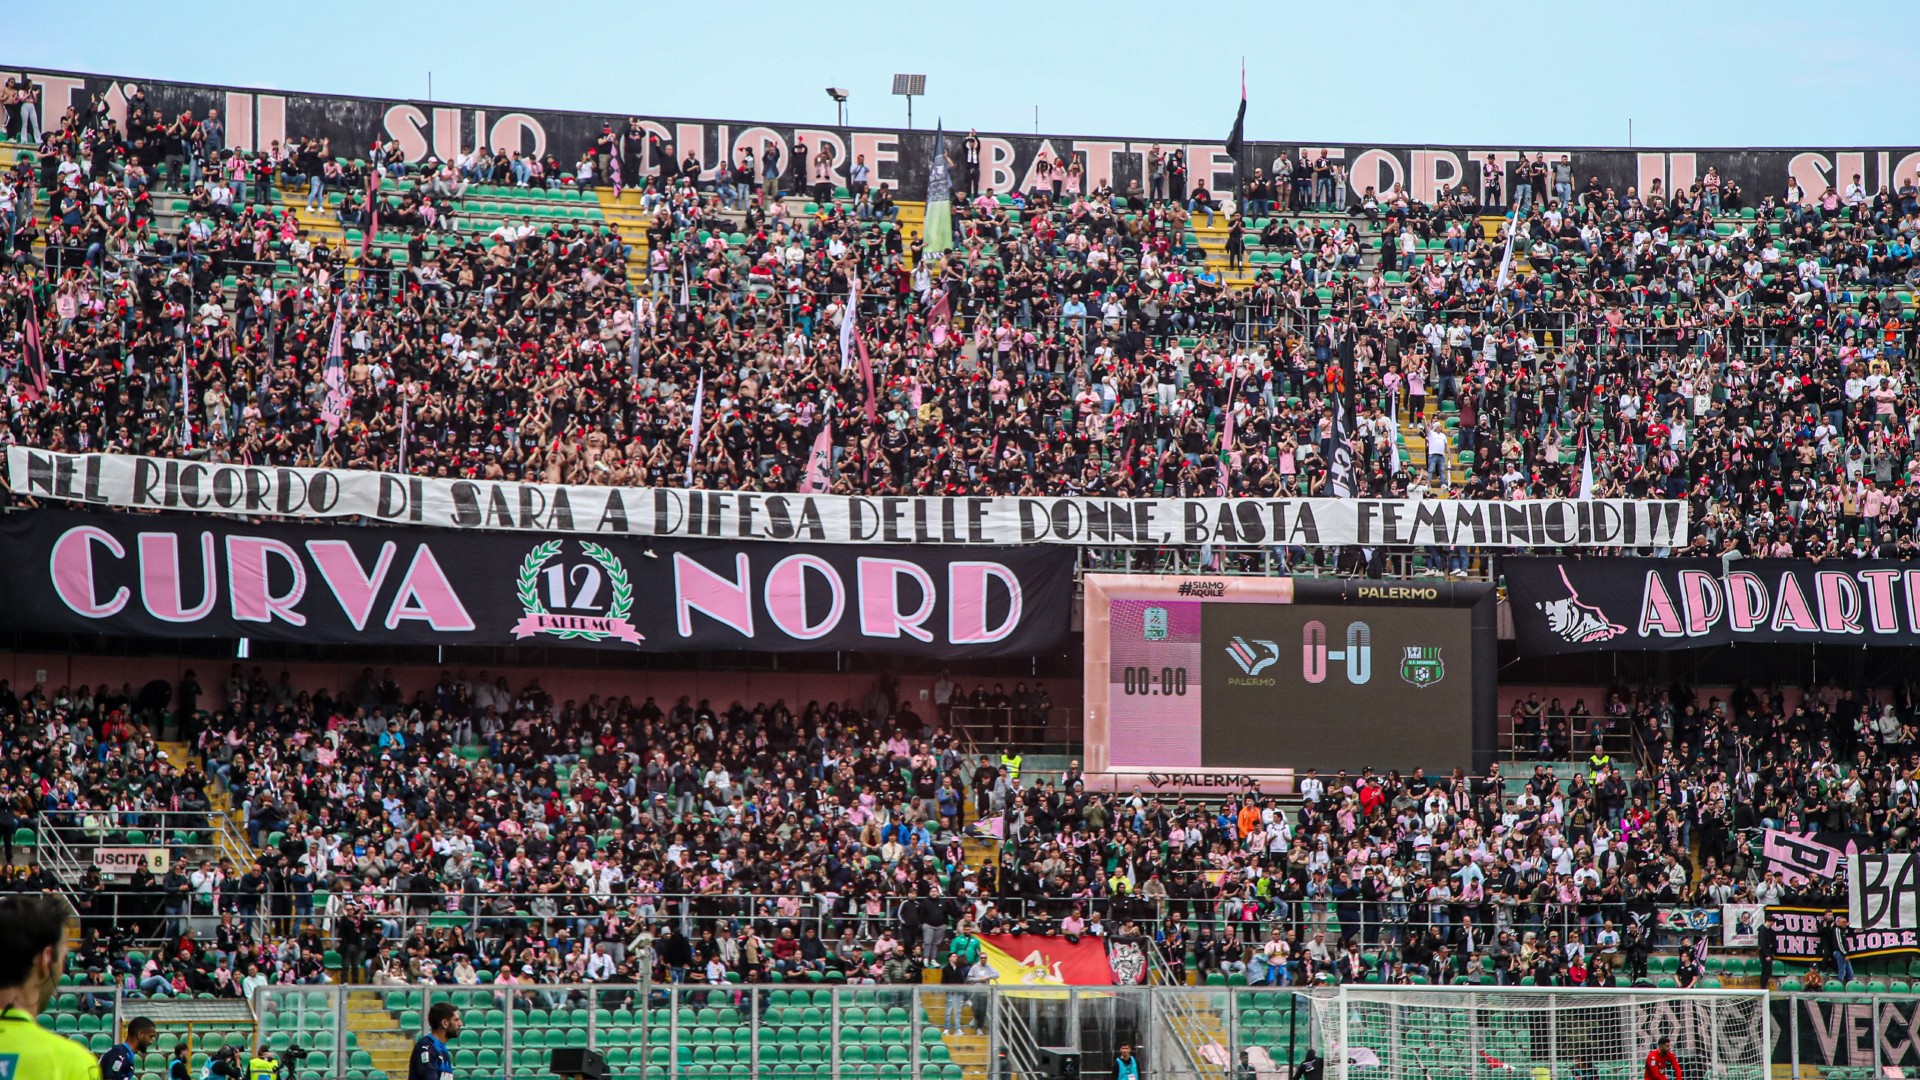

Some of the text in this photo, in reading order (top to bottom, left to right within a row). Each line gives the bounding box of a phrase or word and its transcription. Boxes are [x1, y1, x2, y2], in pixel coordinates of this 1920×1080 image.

[383, 104, 547, 165] SUO
[618, 120, 899, 190] CUORE
[976, 137, 1236, 200] BATTE
[27, 451, 108, 502] NEL
[133, 458, 340, 514] RICORDO
[376, 474, 422, 522] DI
[450, 480, 575, 531] SARA
[596, 488, 629, 532] A
[653, 488, 826, 540] DIFESA
[848, 495, 994, 543] DELLE
[1018, 499, 1171, 543] DONNE,
[1184, 500, 1321, 543] BASTA
[50, 525, 1023, 644] CURVA NORD
[541, 563, 603, 611] 12
[1358, 587, 1438, 600] PALERMO
[1638, 570, 1920, 637] APPART
[537, 615, 617, 632] PALERMO
[1124, 666, 1186, 696] 00:00
[1228, 677, 1275, 687] PALERMO
[1172, 774, 1252, 788] PALERMO
[95, 853, 162, 867] USCITA 8
